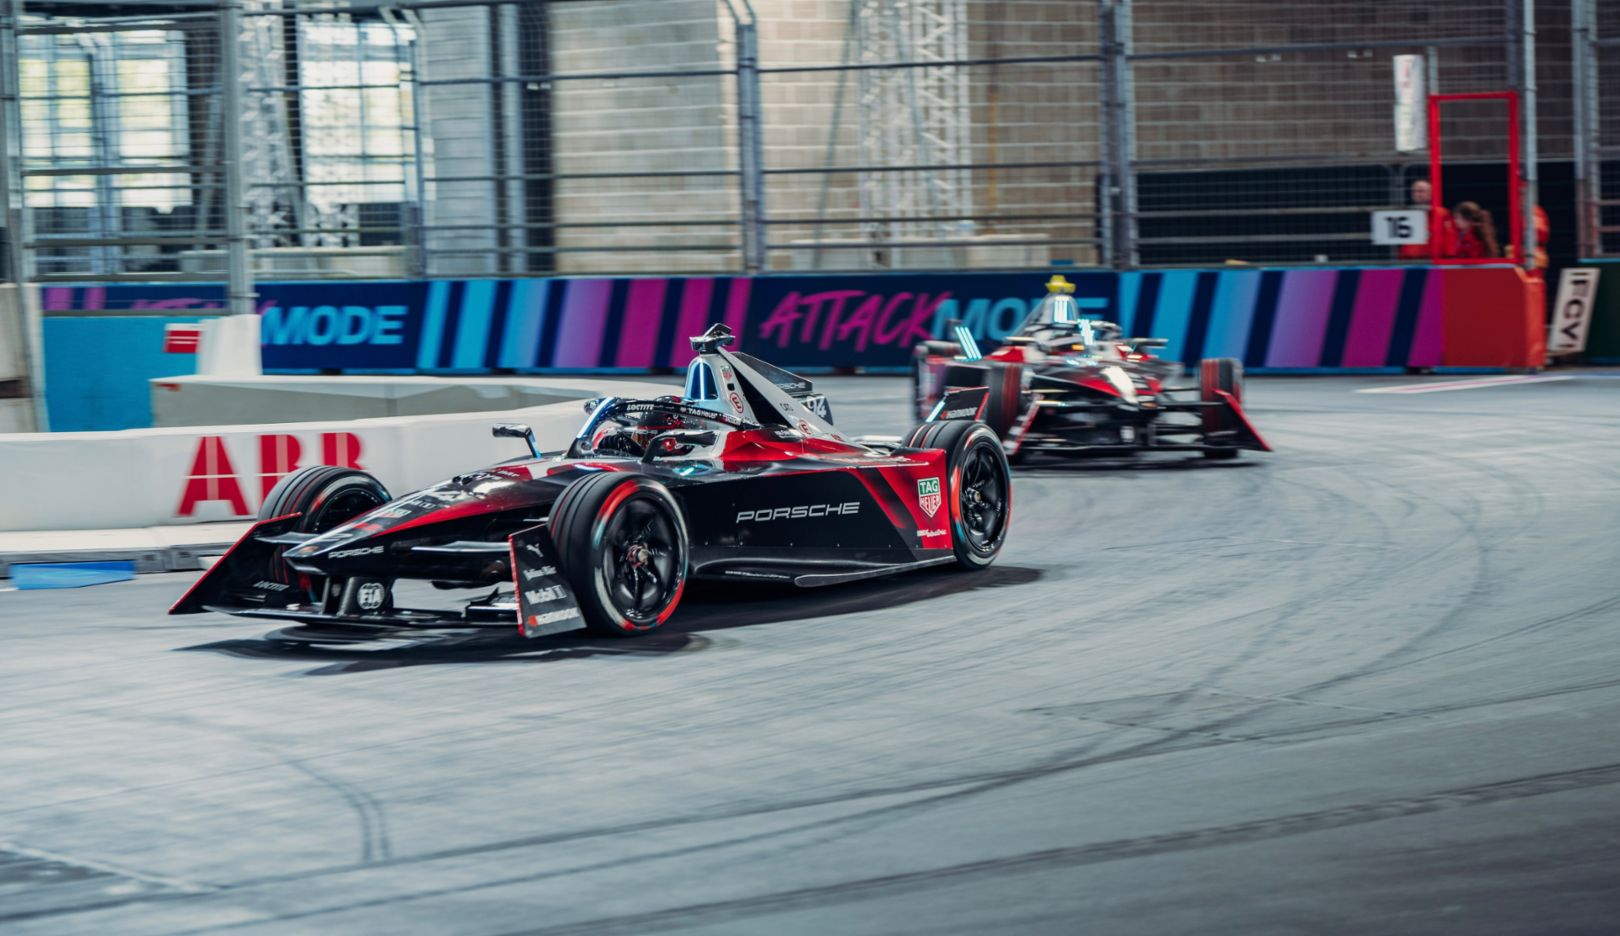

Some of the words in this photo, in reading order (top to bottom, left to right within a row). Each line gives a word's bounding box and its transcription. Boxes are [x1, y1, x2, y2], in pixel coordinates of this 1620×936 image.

[1385, 216, 1412, 238] 16
[261, 305, 408, 346] MODE
[759, 290, 951, 352] ATTACK
[931, 297, 1109, 340] MOE
[806, 395, 827, 417] 94
[919, 480, 939, 495] TAG
[736, 502, 860, 524] PORSCHE
[328, 545, 385, 559] PORSCHE
